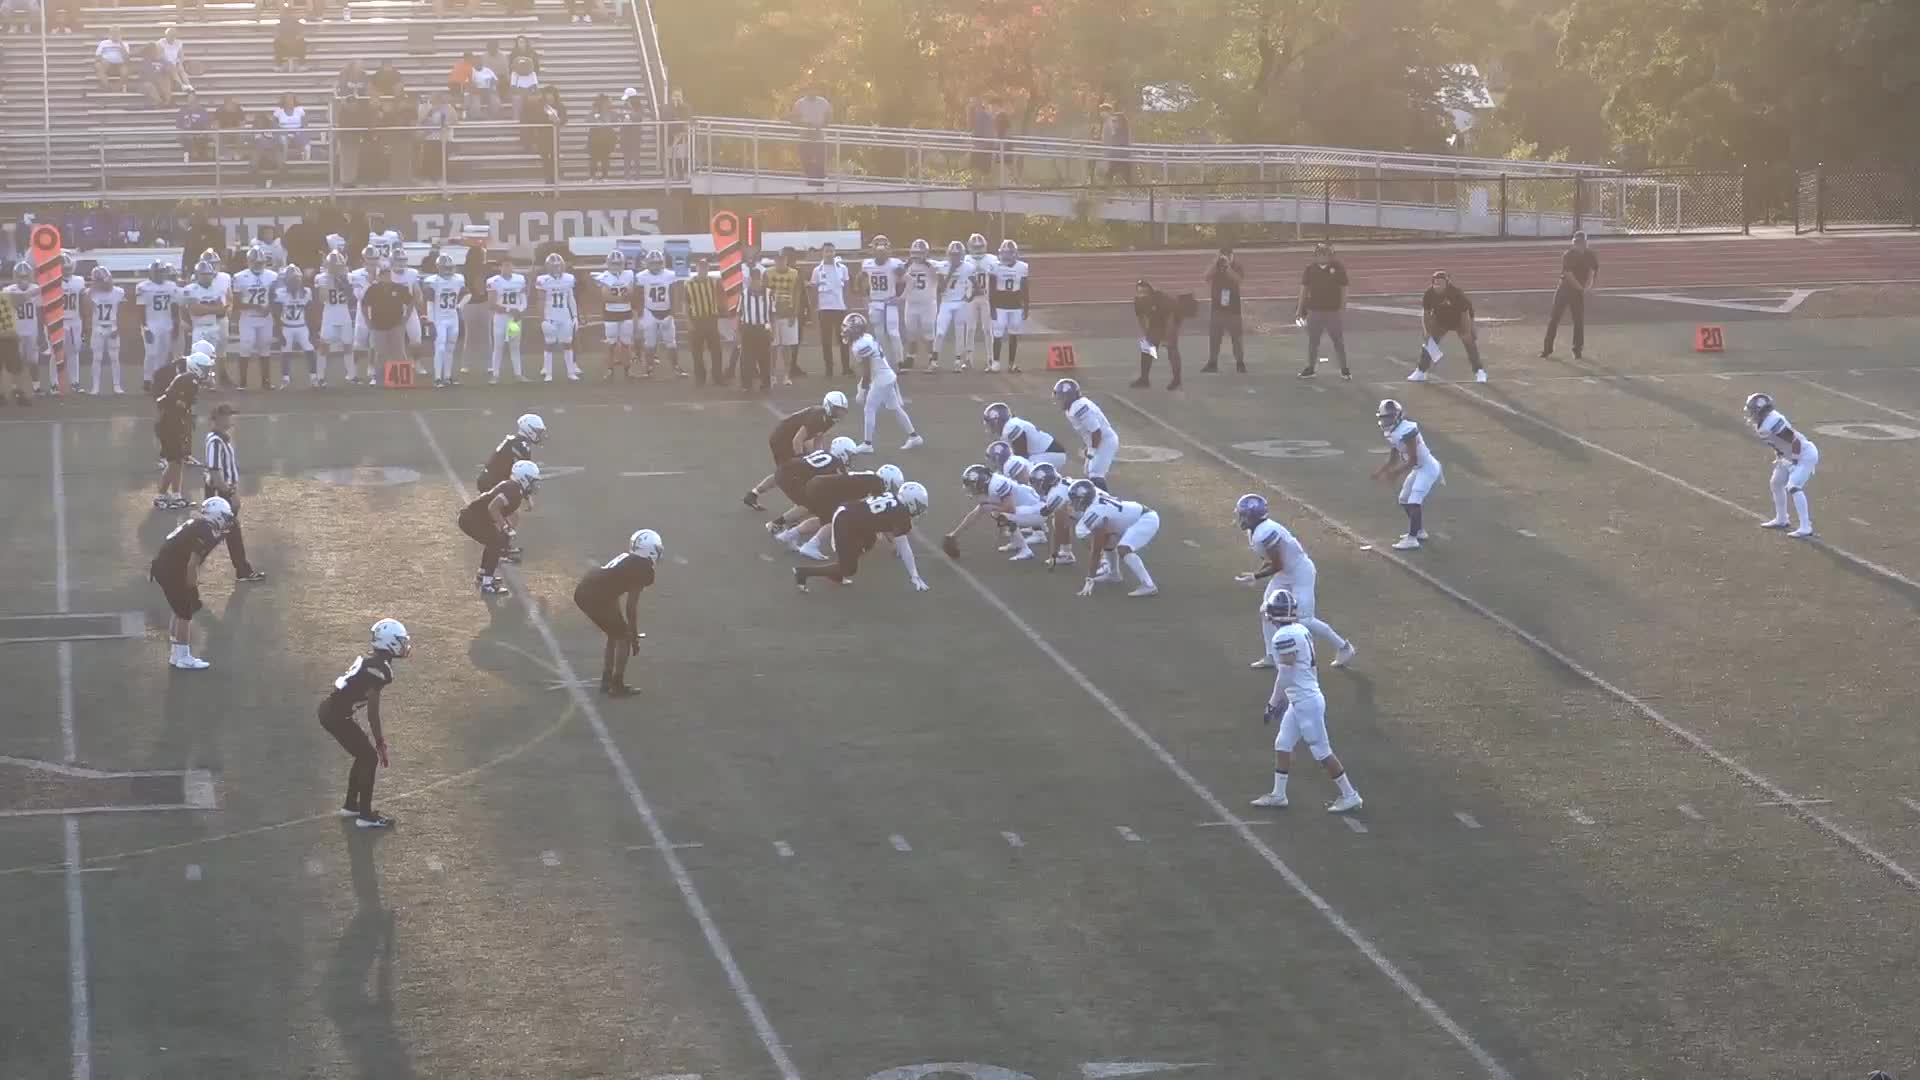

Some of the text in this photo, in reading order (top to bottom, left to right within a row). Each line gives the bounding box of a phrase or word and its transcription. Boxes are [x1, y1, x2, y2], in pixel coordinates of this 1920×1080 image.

[1701, 327, 1722, 348] 20
[1052, 346, 1074, 366] 30
[390, 363, 411, 385] 40
